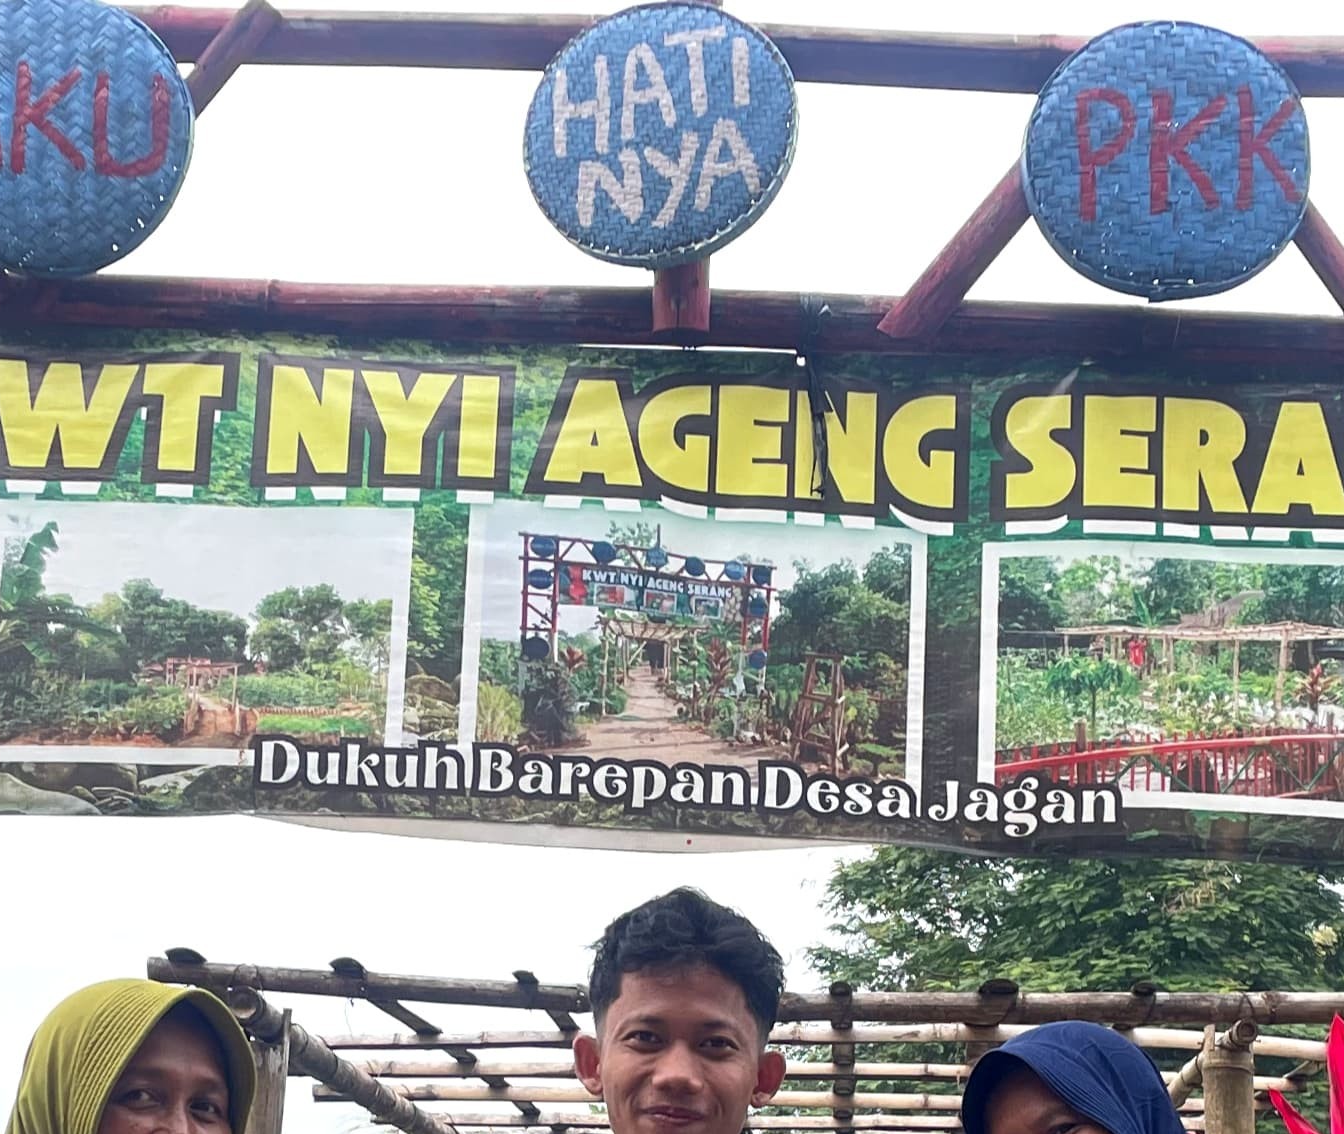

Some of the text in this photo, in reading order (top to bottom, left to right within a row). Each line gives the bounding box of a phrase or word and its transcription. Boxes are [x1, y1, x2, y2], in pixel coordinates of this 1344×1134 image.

[553, 25, 751, 158] HATI
[1075, 83, 1304, 223] PKK
[576, 116, 761, 229] NYA
[263, 362, 502, 480] NYI
[541, 377, 957, 511] AGENG
[582, 568, 617, 583] KWT
[620, 572, 643, 587] NYI
[258, 738, 1121, 837] Dukuh Barepan Desa Jagan
